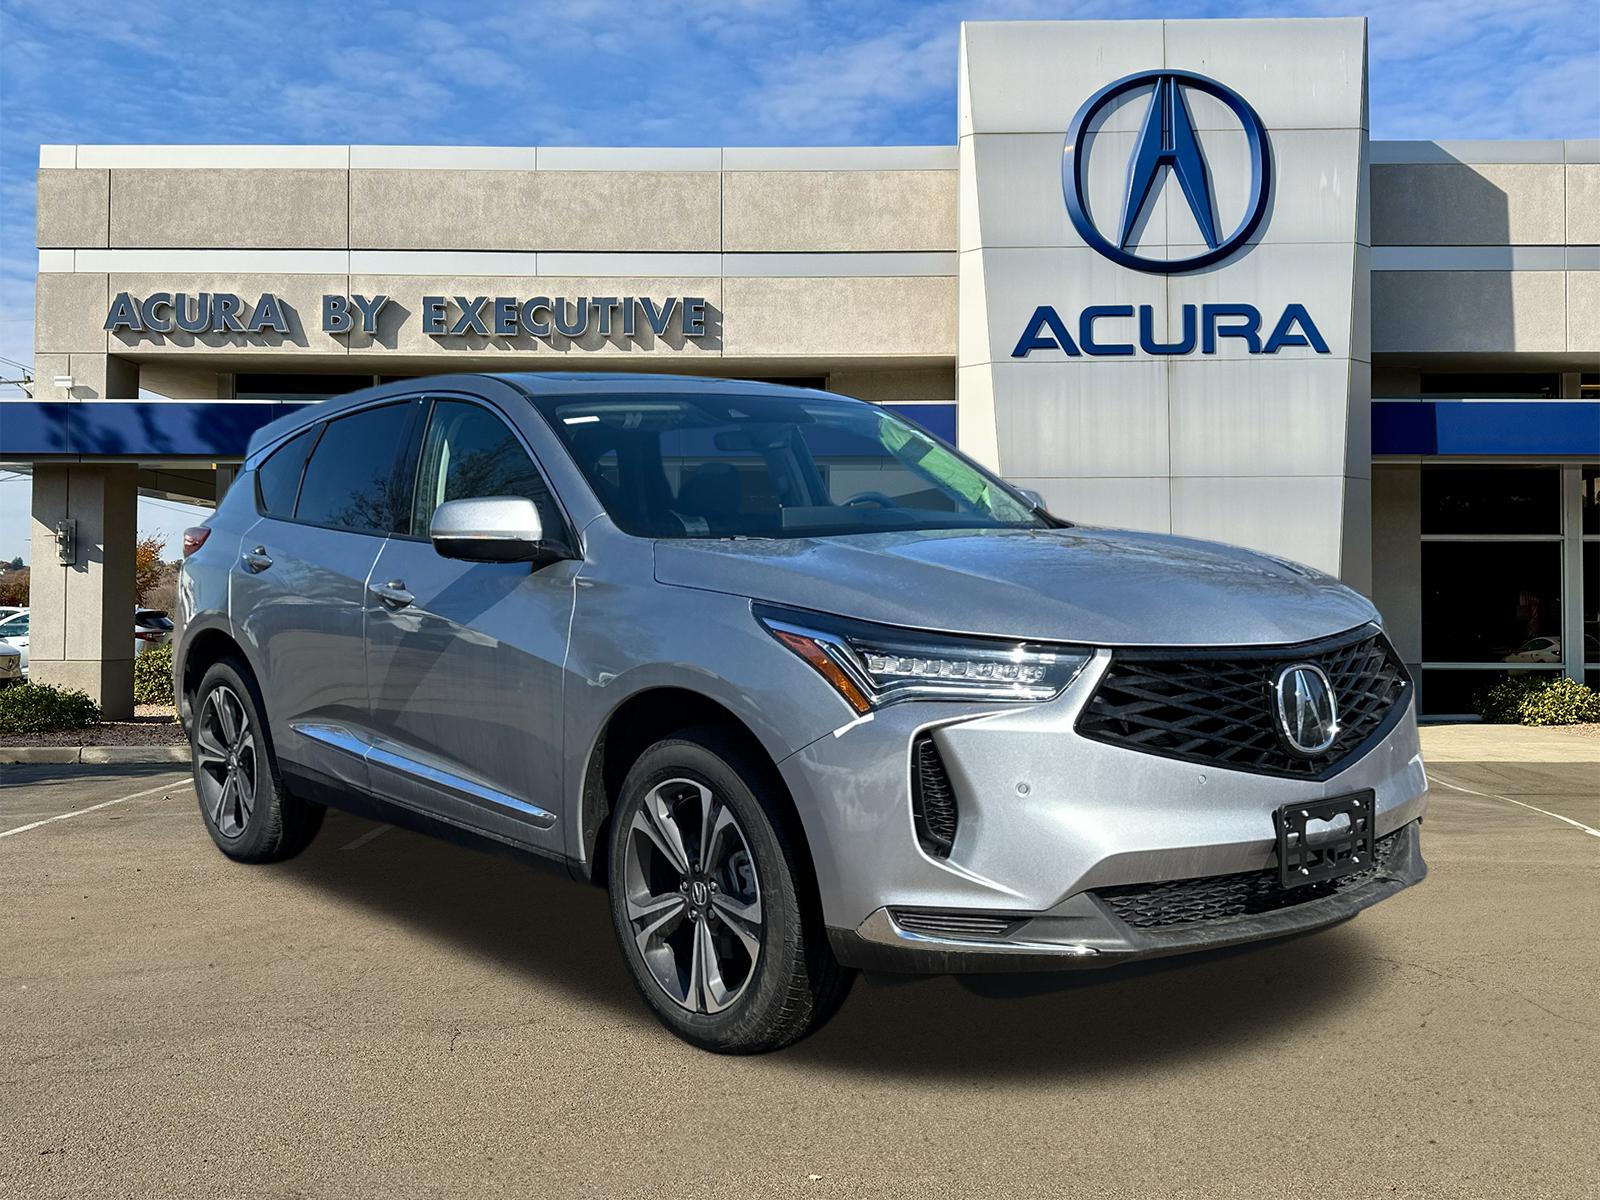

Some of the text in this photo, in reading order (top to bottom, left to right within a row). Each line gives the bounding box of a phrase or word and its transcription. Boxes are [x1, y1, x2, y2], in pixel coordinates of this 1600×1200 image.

[104, 292, 706, 337] ACURA BY EXECUTIVE
[1011, 303, 1331, 357] ACURA
